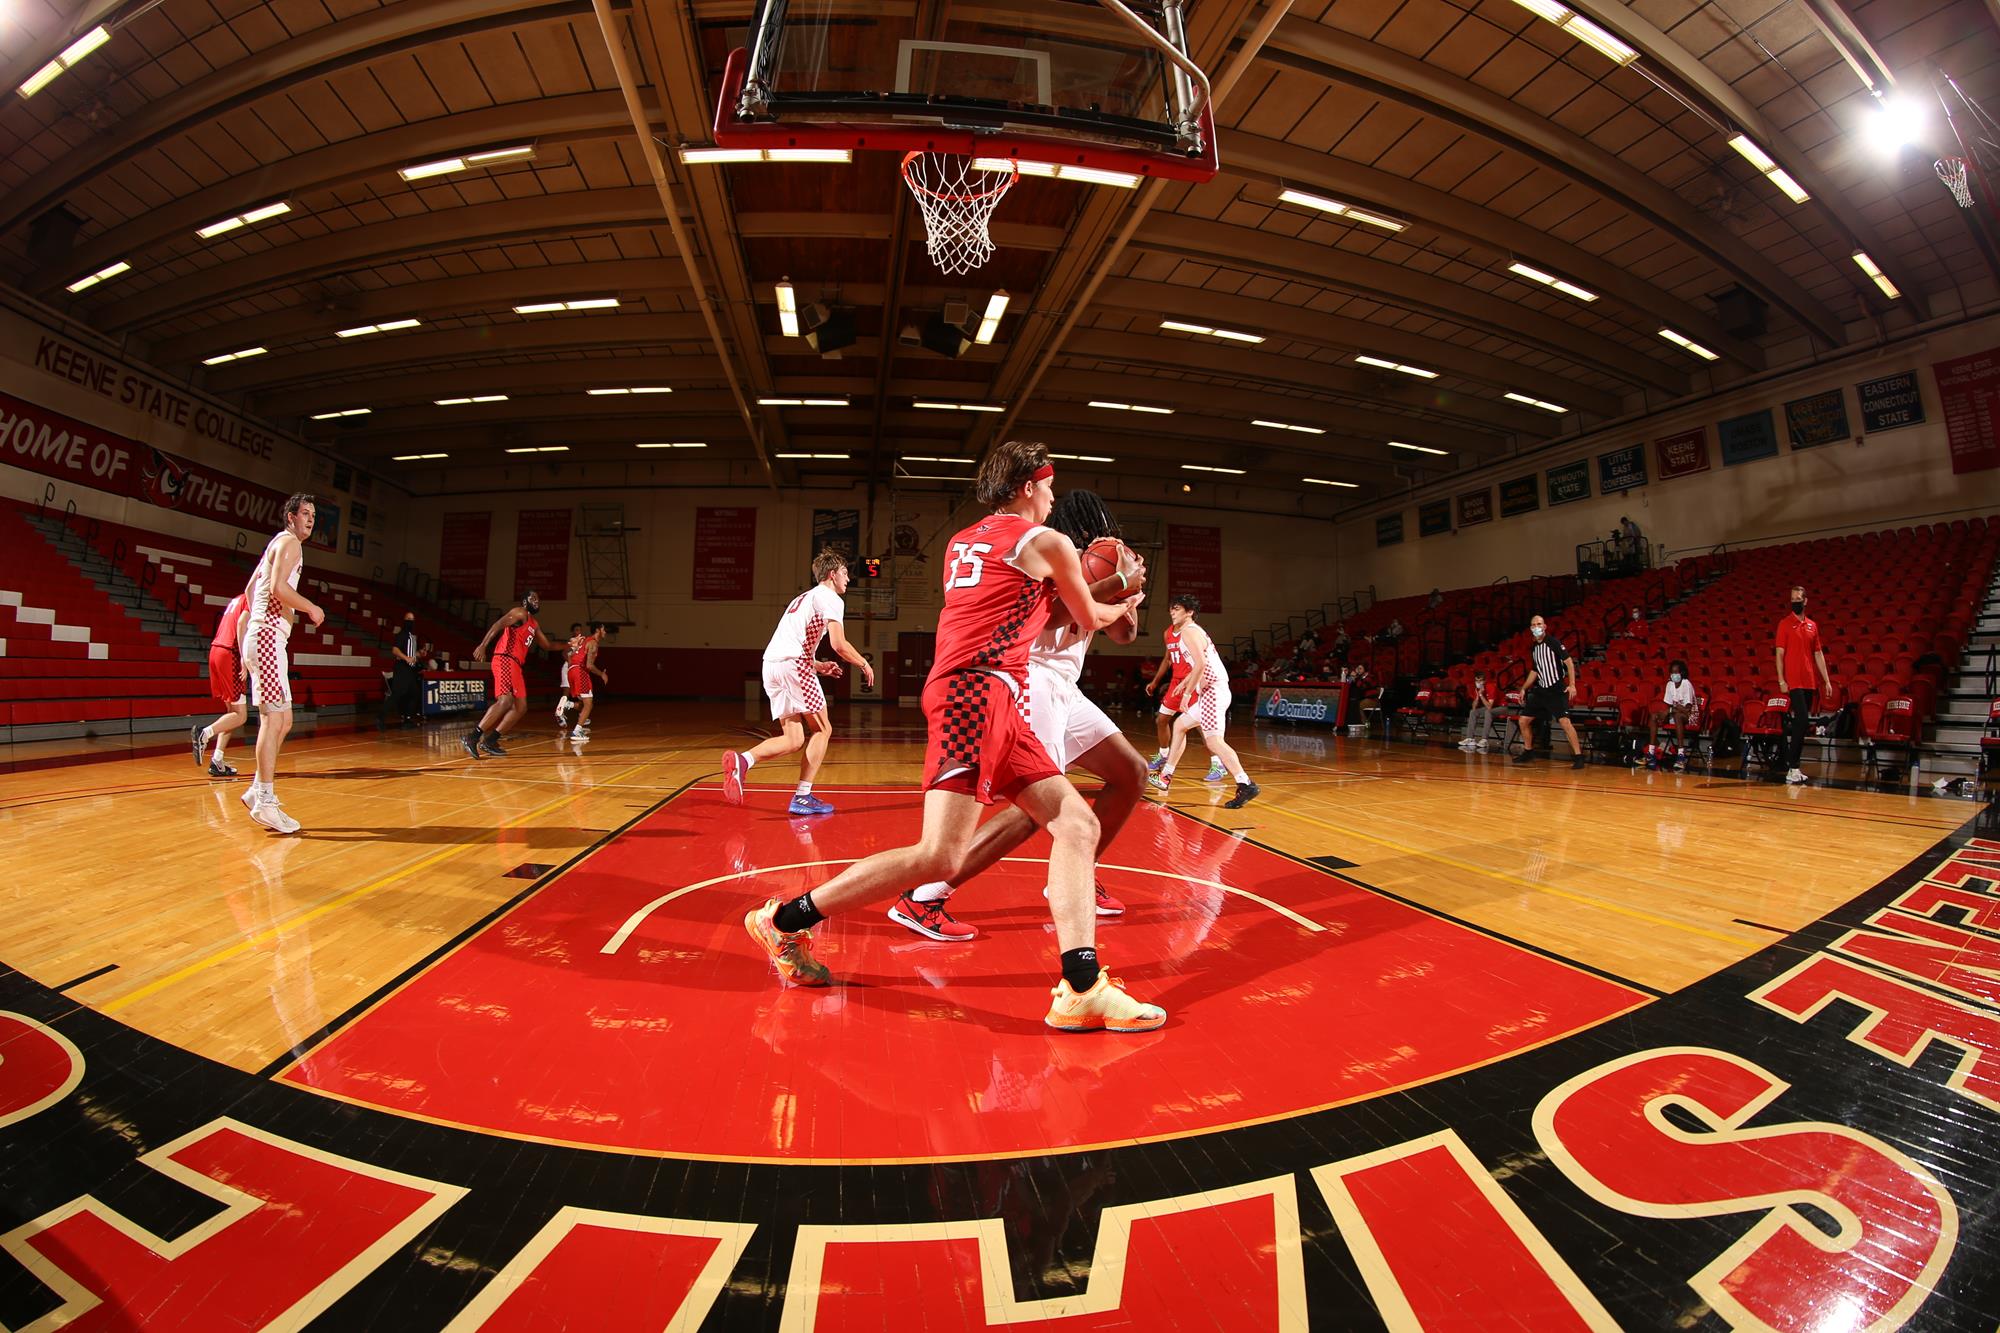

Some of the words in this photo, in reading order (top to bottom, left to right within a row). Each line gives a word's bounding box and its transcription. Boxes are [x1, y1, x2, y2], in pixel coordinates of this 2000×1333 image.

[1864, 375, 1912, 396] EASTERN
[35, 336, 118, 397] KEENE
[120, 375, 191, 427] STATE
[194, 407, 275, 461] COLLEGE
[1863, 391, 1918, 413] CONNECTICUT
[1878, 410, 1913, 426] STATE
[1666, 439, 1696, 455] KEENE
[0, 408, 88, 471] HOME
[90, 443, 130, 481] OF
[184, 473, 231, 513] THE
[1608, 450, 1633, 465] LITTLE
[1670, 452, 1696, 468] STATE
[1611, 463, 1633, 476] EAST
[1602, 471, 1646, 489] CONFERENCE
[1557, 483, 1581, 497] STATE
[439, 680, 465, 693] BEEZE
[465, 680, 485, 693] TEES
[439, 693, 461, 704] SCREEN
[1277, 699, 1328, 720] Domino's
